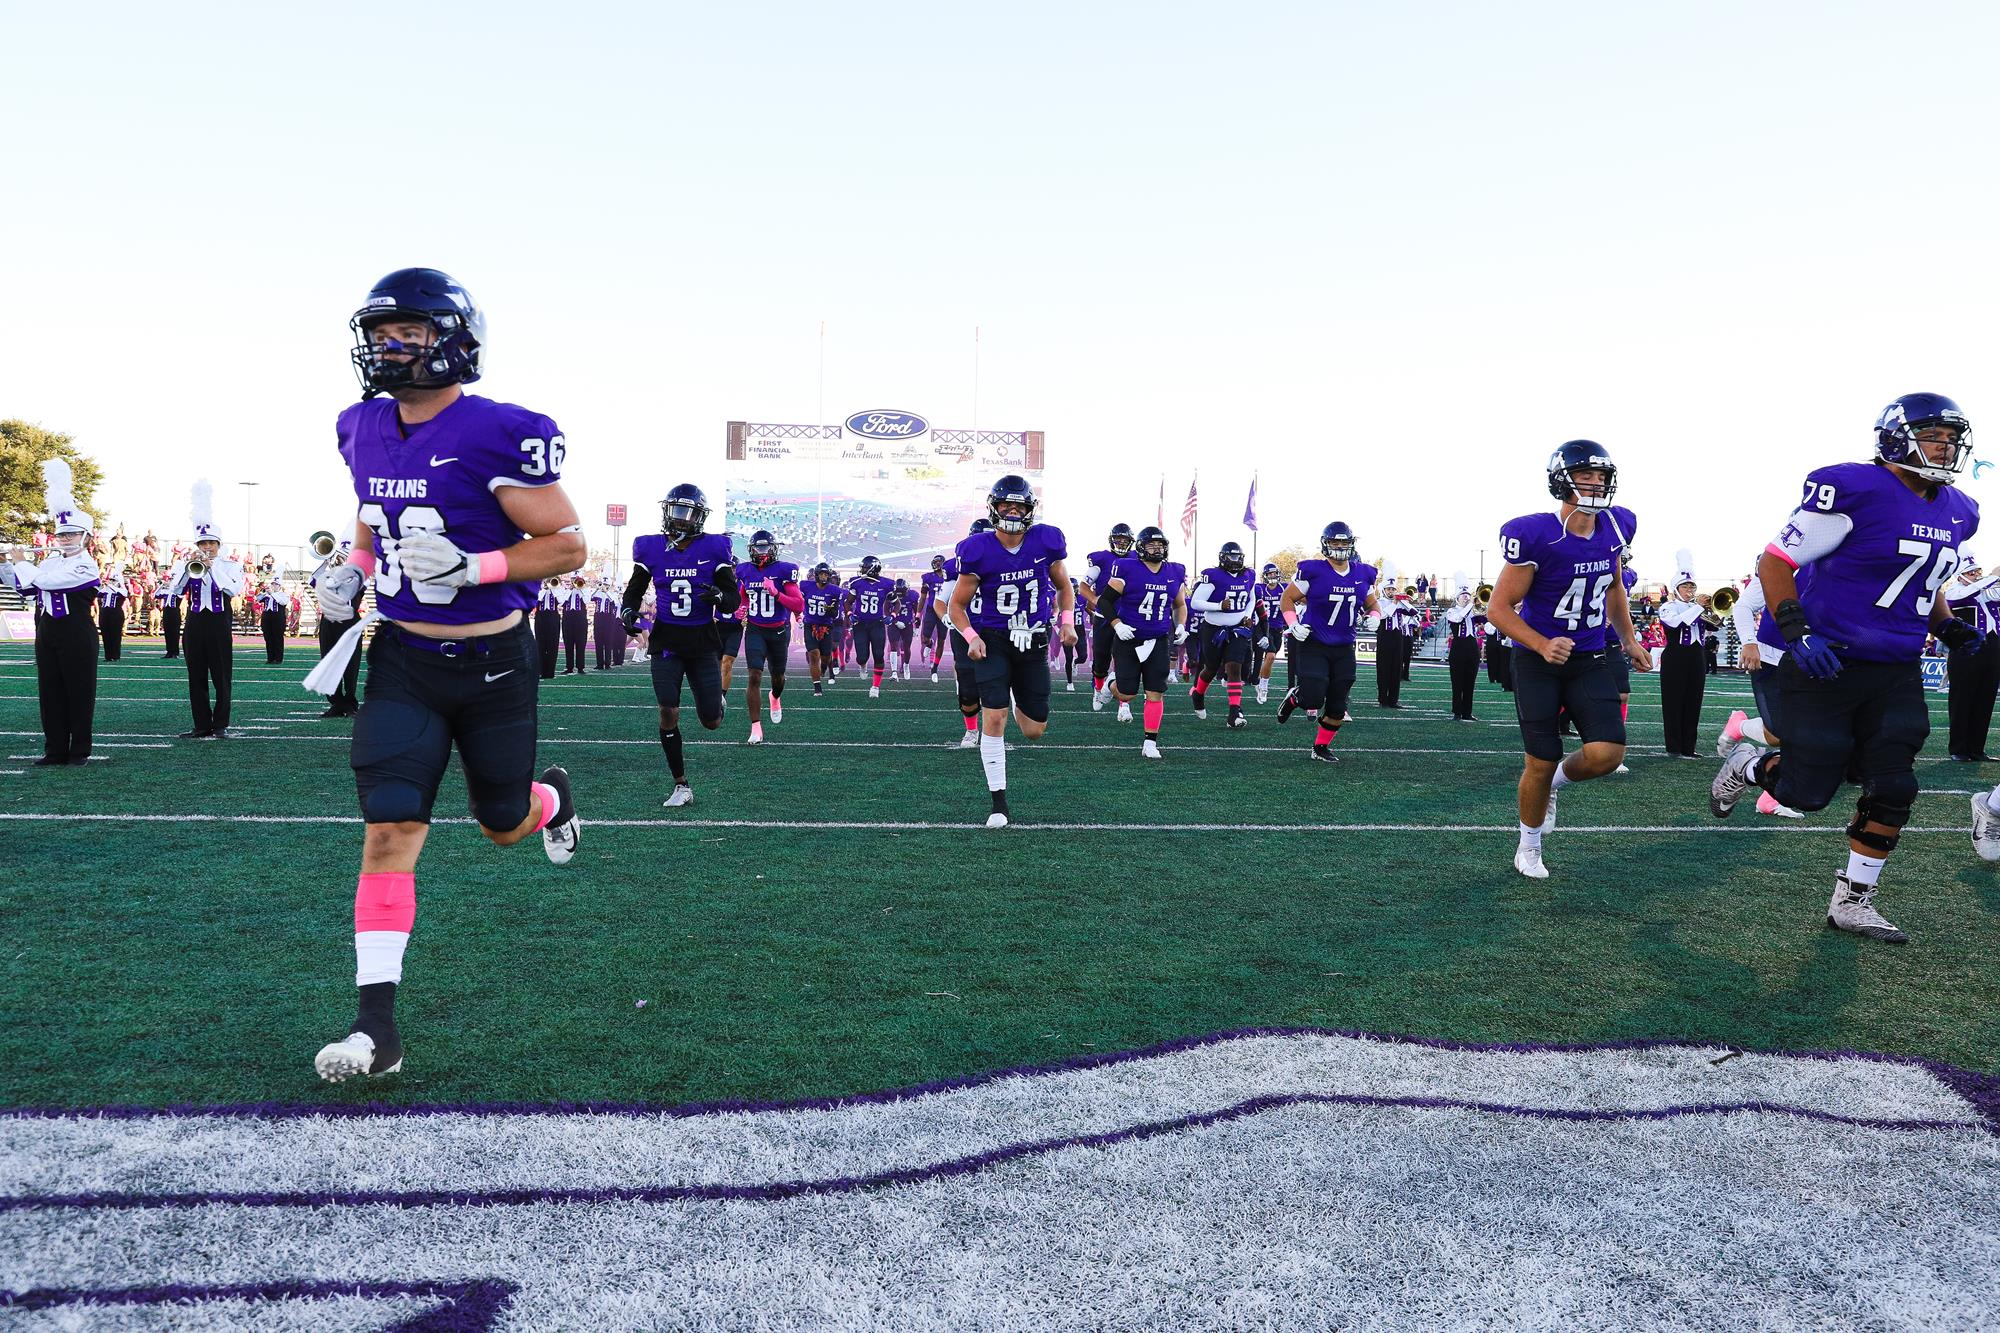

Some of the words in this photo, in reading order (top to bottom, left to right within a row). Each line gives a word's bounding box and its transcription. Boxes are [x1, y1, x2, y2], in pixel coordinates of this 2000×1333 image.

[862, 413, 914, 434] Ford
[521, 436, 564, 476] 36
[842, 450, 883, 459] InterBank
[982, 458, 1023, 466] TexasBank
[368, 477, 427, 498] TEXANS
[1802, 481, 1836, 510] 79
[1911, 523, 1952, 543] TEXANS
[1500, 535, 1521, 559] 49
[665, 569, 697, 577] TEXANS
[1000, 569, 1034, 581] TEXANS
[1573, 559, 1610, 575] TEXANS
[1875, 539, 1959, 616] 79
[670, 580, 692, 617] 3
[860, 594, 879, 615] 58
[1138, 591, 1168, 621] 41
[1224, 590, 1249, 610] 50
[1553, 573, 1614, 631] 49
[1327, 593, 1357, 627] 71
